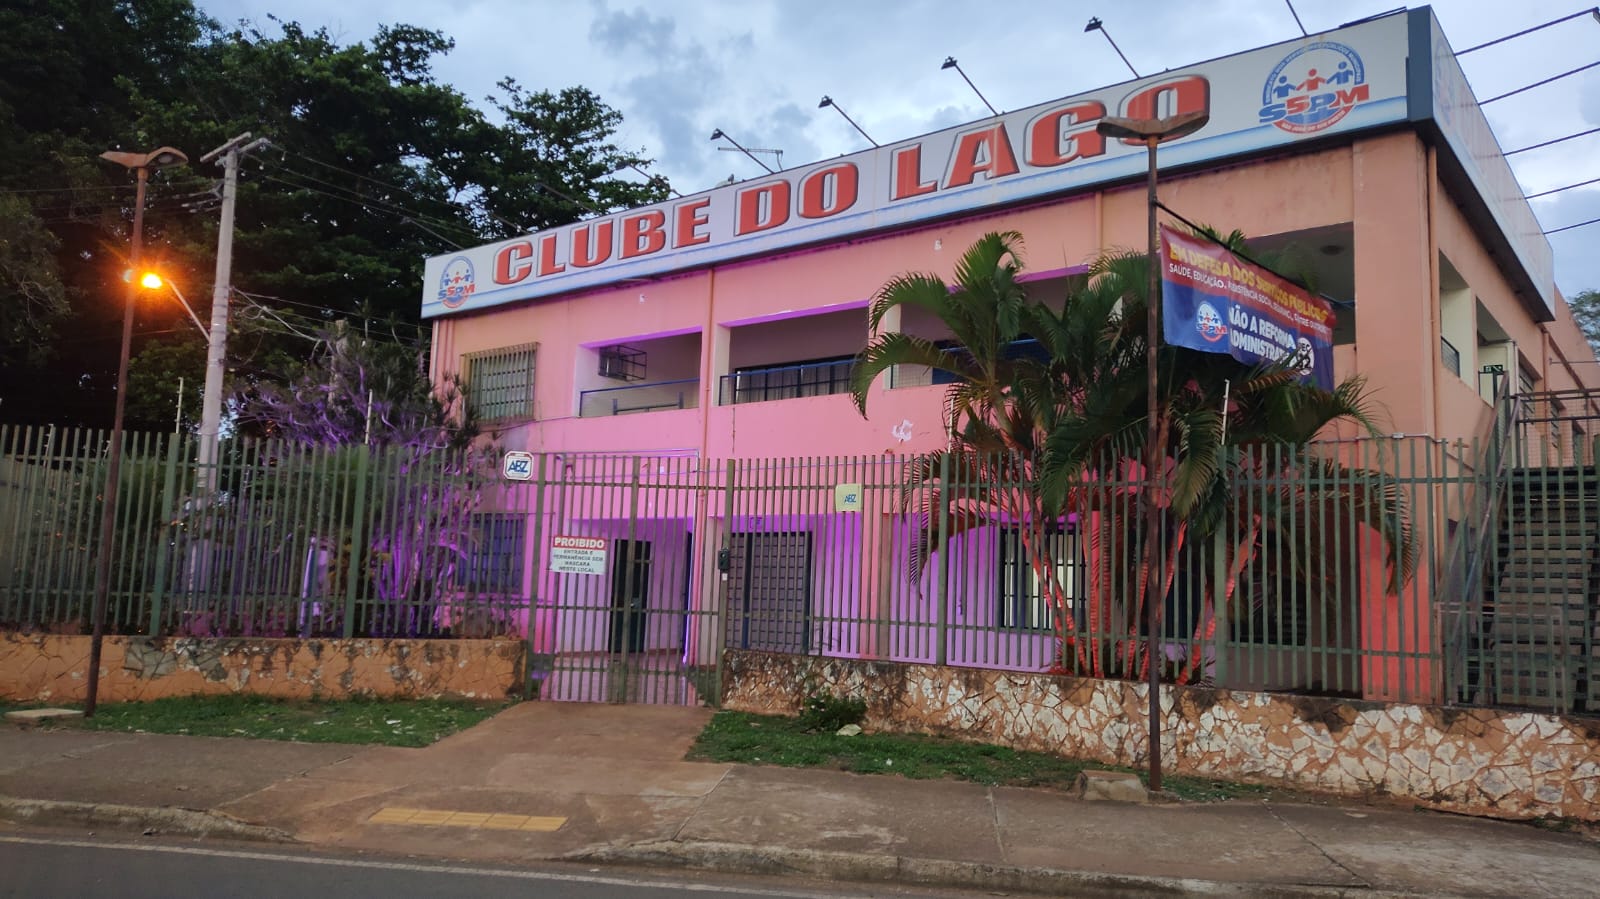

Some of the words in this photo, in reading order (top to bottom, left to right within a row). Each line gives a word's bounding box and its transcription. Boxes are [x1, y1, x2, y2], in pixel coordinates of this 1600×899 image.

[1258, 84, 1369, 123] SSPM
[493, 196, 711, 285] CLUBE
[734, 161, 859, 237] DO
[890, 74, 1210, 201] LAGO
[1170, 242, 1188, 263] EM
[1188, 249, 1232, 277] DEFESA
[1233, 264, 1255, 288] DOS
[438, 283, 475, 300] SSPM
[1228, 304, 1249, 329] NÃO
[1249, 316, 1258, 334] A
[1259, 319, 1296, 349] REFORMA
[508, 460, 528, 473] ABZ
[554, 537, 605, 549] PROIBIDO
